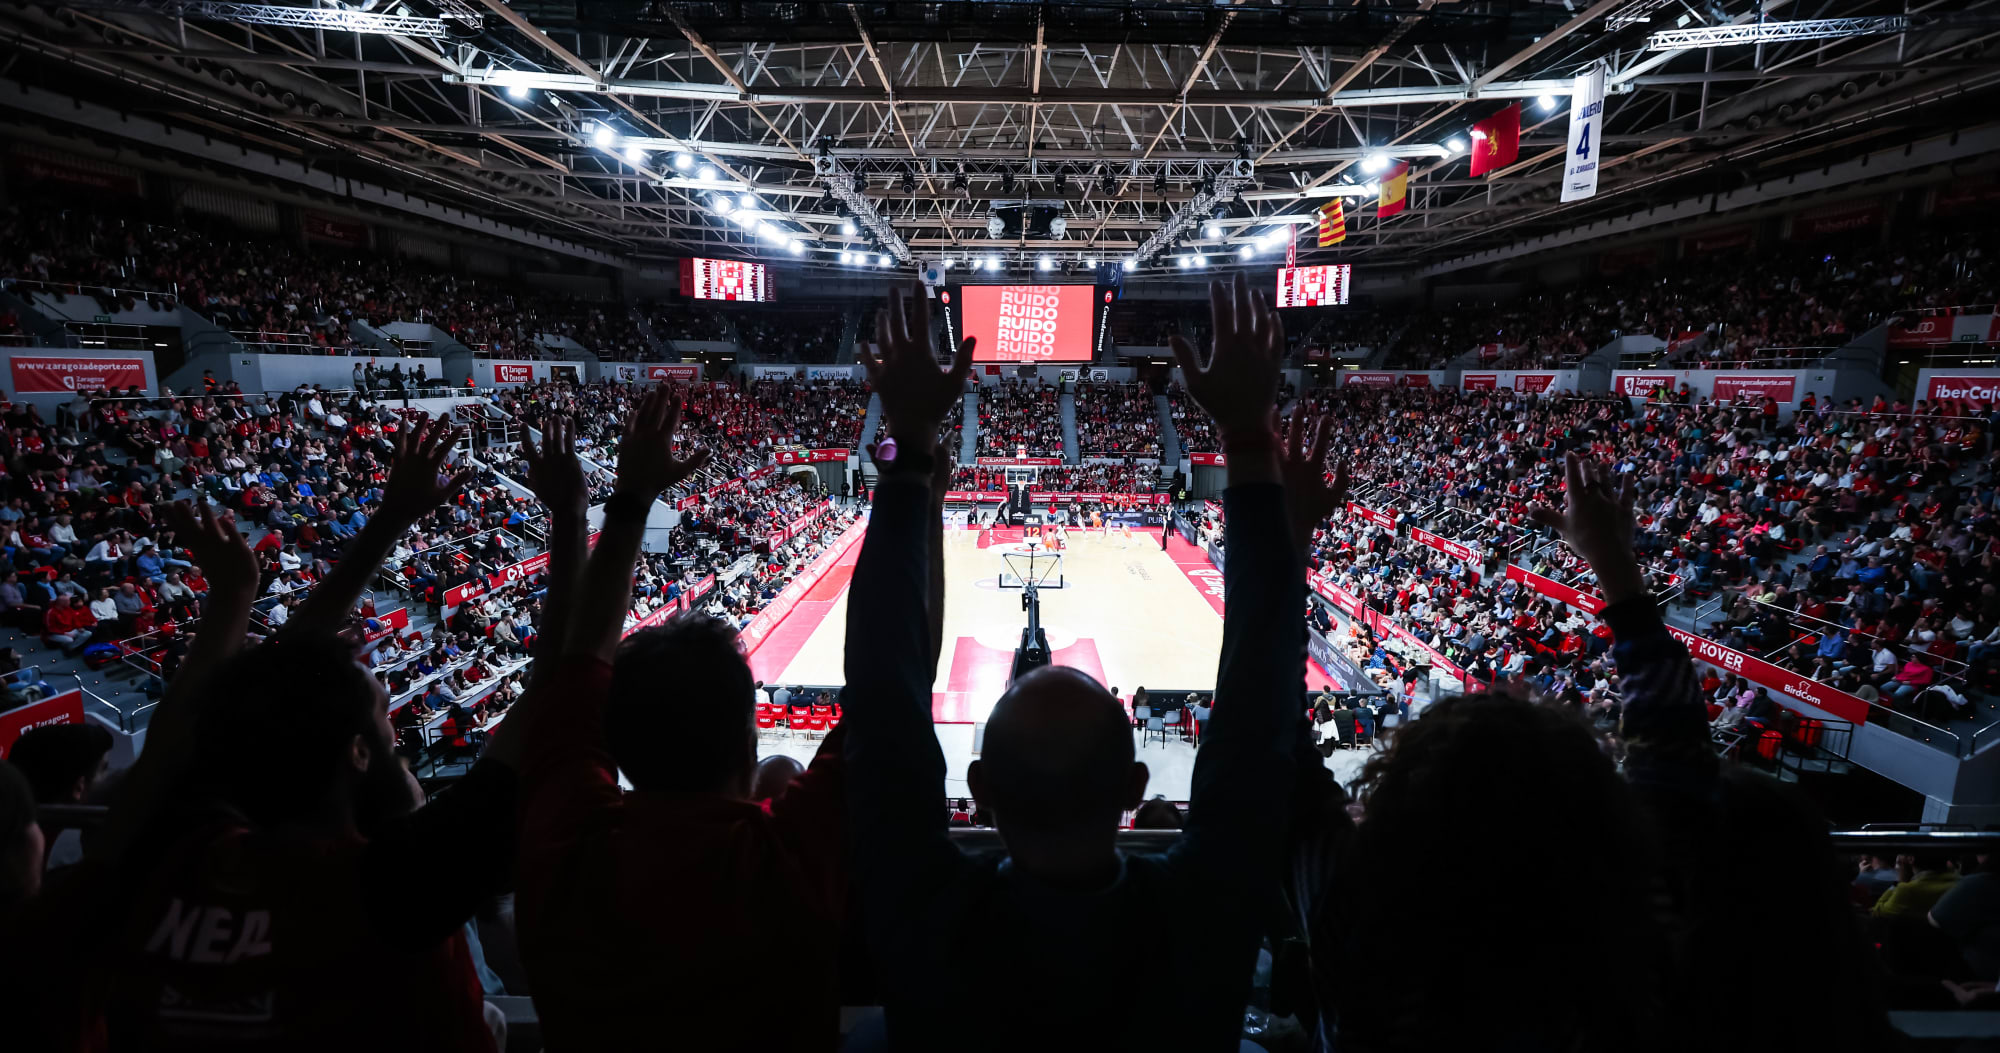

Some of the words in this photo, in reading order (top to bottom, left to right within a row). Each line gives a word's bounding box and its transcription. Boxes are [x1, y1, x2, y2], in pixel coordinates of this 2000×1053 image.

[1576, 122, 1590, 160] 4
[1001, 292, 1059, 308] RUIDO
[1000, 304, 1058, 320] RUIDO
[998, 316, 1056, 332] RUIDO
[997, 328, 1056, 345] RUIDO
[996, 341, 1054, 356] RUIDO
[16, 362, 140, 372] www.zaragozadeporte.com
[508, 366, 528, 374] Zaragoza
[1026, 527, 1040, 538] 12
[1699, 642, 1744, 668] KOVER
[1784, 684, 1821, 705] BirdCom
